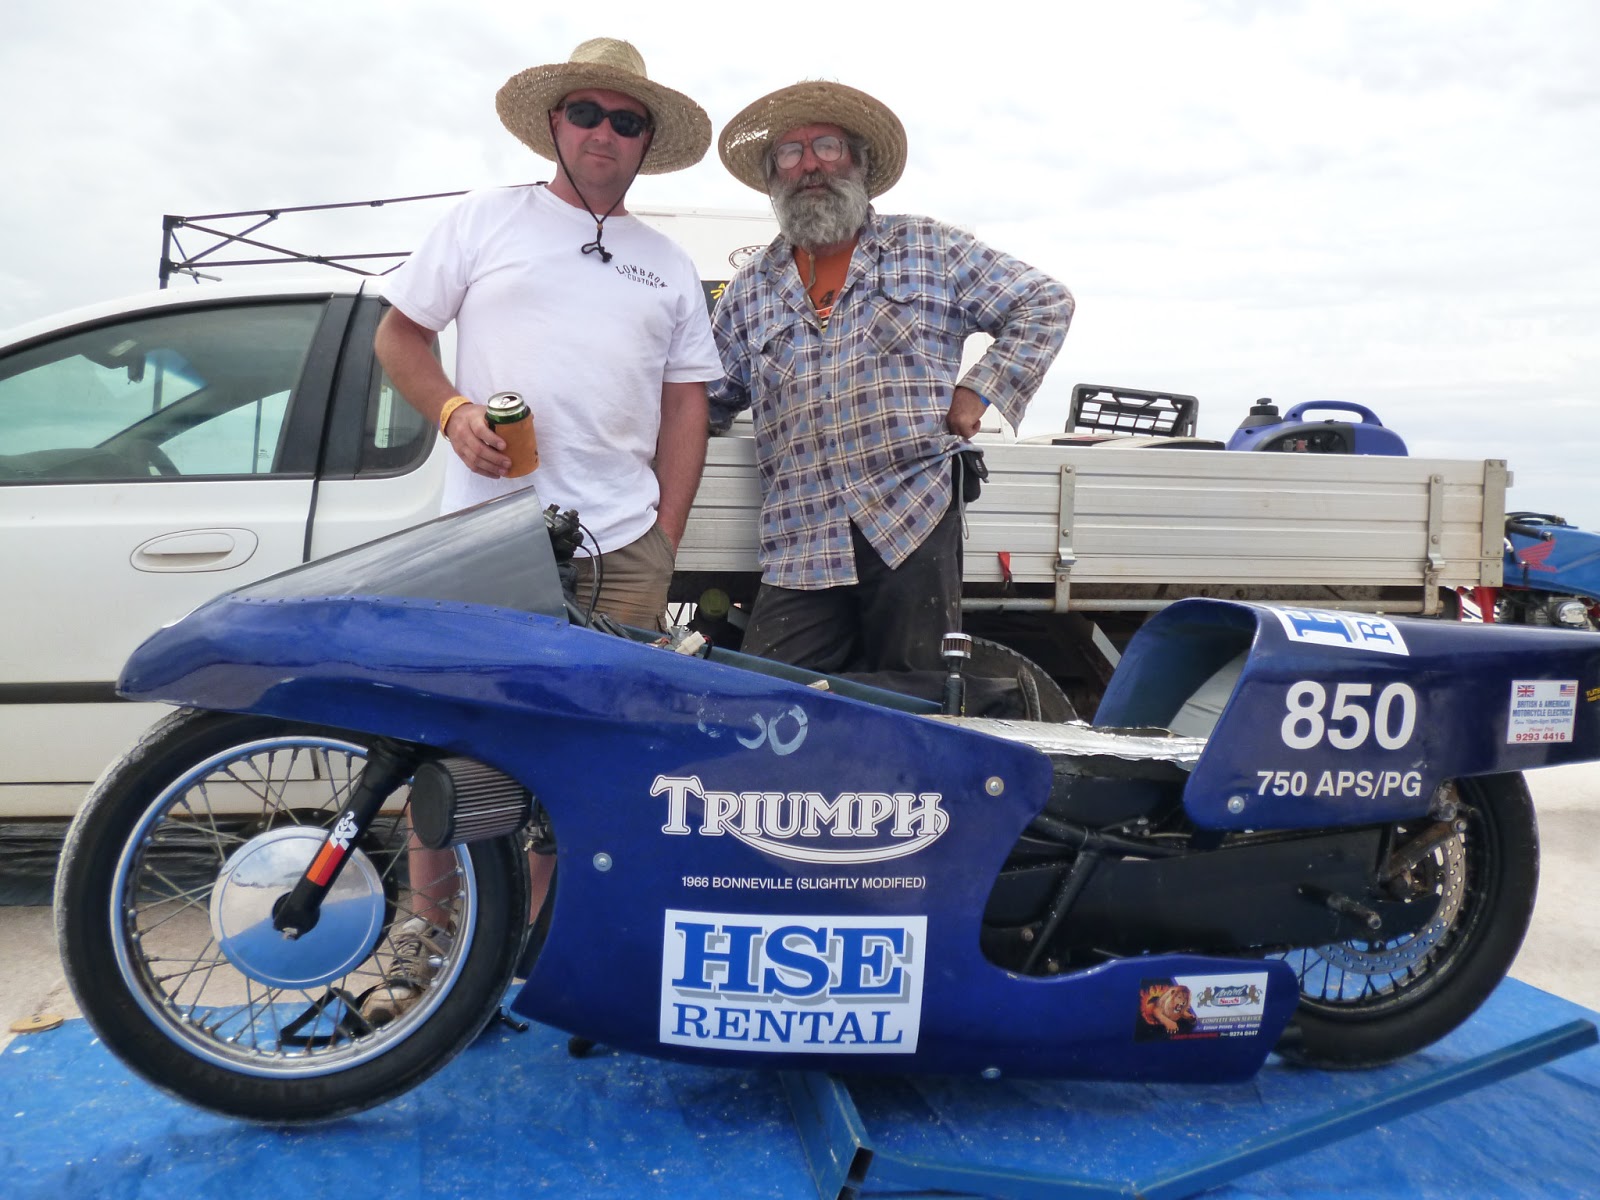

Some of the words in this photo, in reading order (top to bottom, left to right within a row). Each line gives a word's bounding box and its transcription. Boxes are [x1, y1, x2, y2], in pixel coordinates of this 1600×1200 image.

[615, 264, 668, 288] LOWBROW
[627, 273, 658, 289] CUSTOMS
[1281, 680, 1417, 750] 850
[1512, 709, 1546, 717] MOTORCYCLE
[1547, 709, 1573, 717] ELECTRICS
[1517, 700, 1538, 708] BRITISH
[1544, 700, 1571, 708] AMERICAN
[1516, 733, 1540, 741] 9293
[1543, 732, 1566, 741] 4416
[1257, 771, 1308, 797] 750
[1314, 771, 1422, 799] APS/PG
[650, 774, 949, 865] TRIUMPH
[681, 876, 709, 888] 1966
[712, 877, 793, 890] BONNEVILLE
[796, 876, 859, 891] (SLIGHTLY
[862, 876, 926, 890] MODIFIED)
[671, 921, 909, 1002] HSE
[671, 1002, 904, 1045] RENTAL
